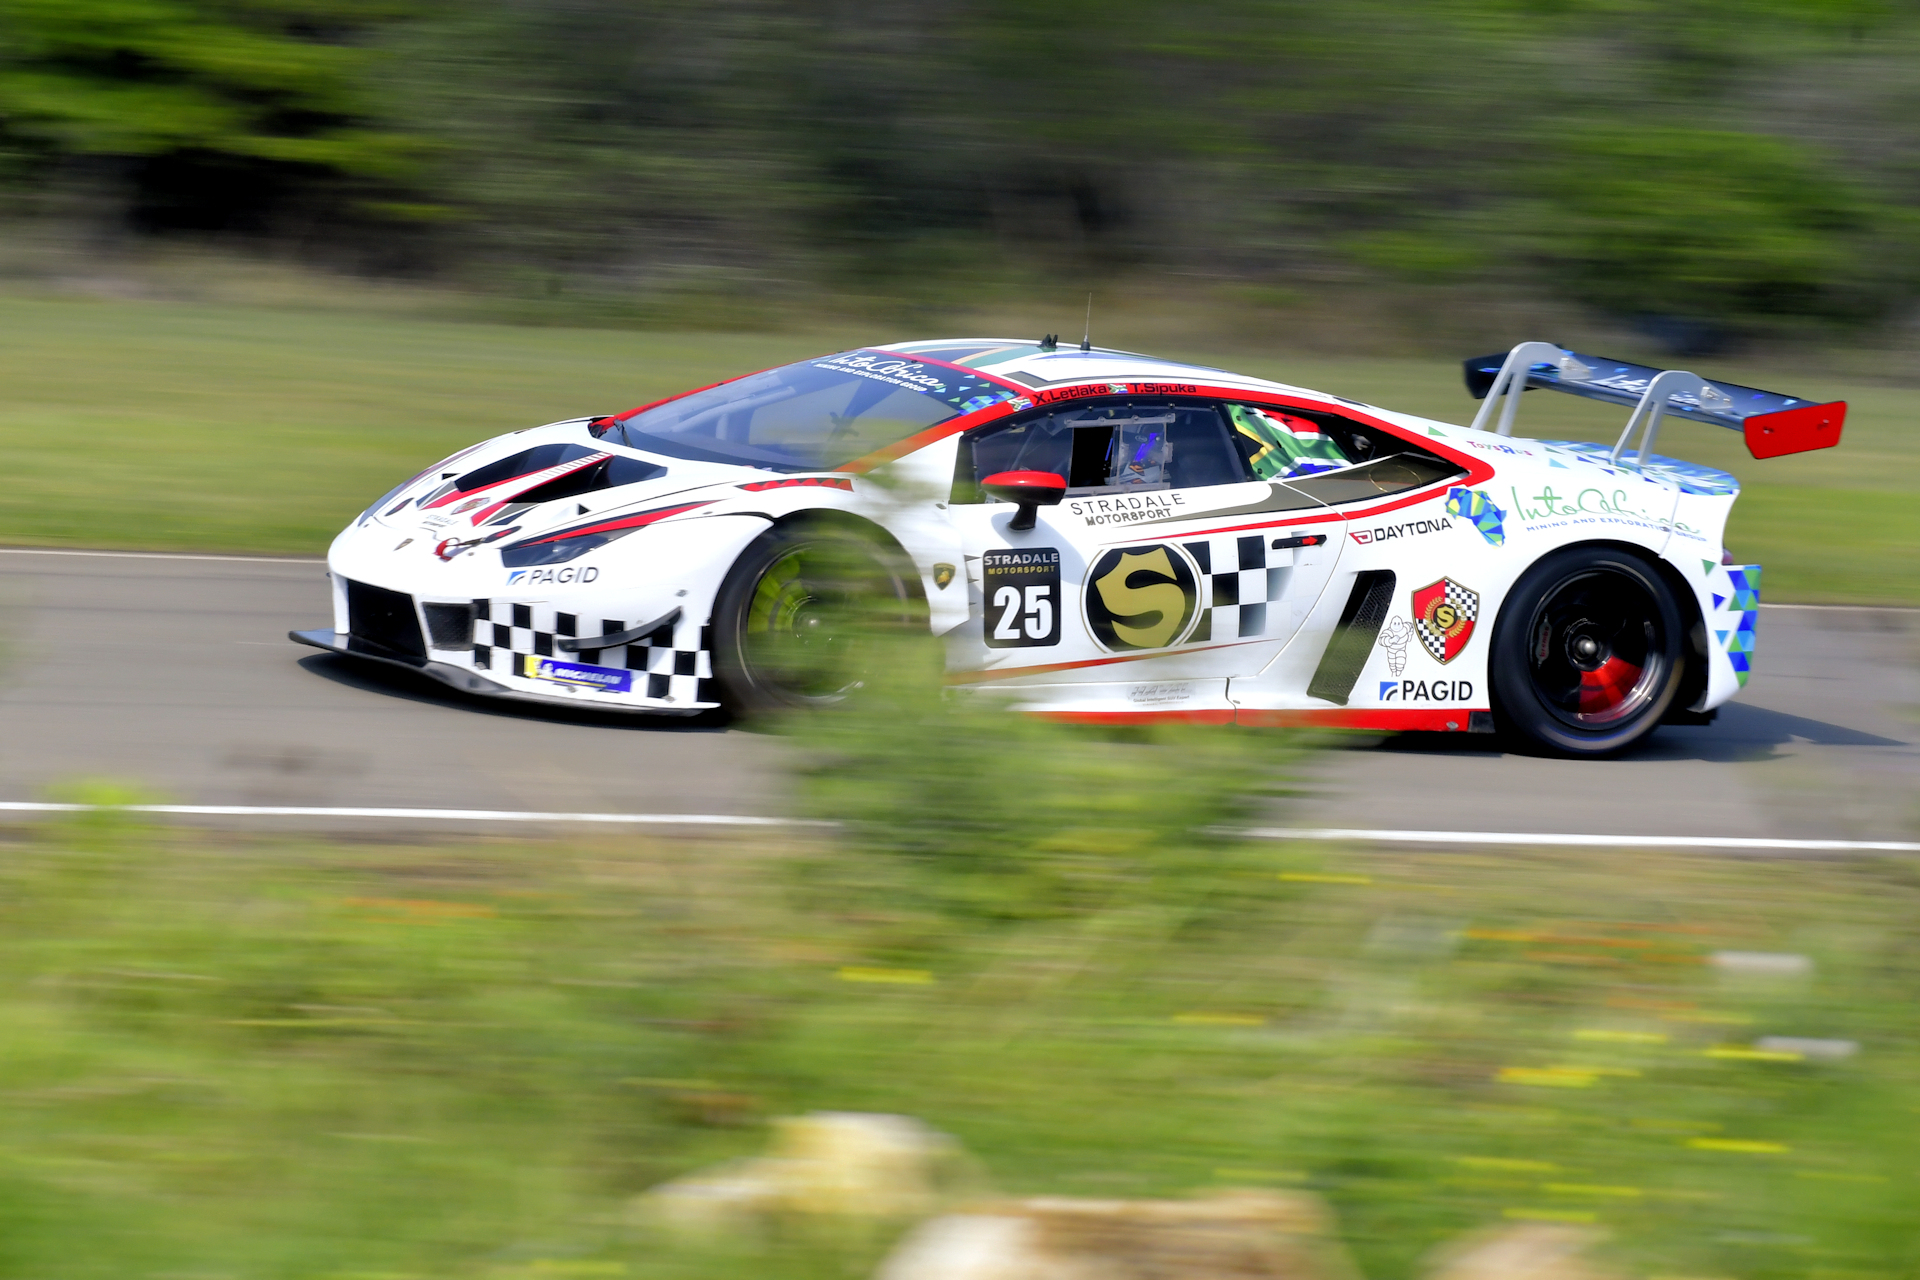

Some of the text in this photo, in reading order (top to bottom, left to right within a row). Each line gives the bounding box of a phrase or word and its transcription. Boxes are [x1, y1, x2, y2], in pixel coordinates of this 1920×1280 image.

[1070, 493, 1186, 515] STRADALE
[1085, 508, 1172, 526] MOTORSPORT
[1525, 520, 1569, 532] MINING
[1573, 517, 1597, 526] AND
[1374, 517, 1453, 542] DAYTONA
[984, 553, 1059, 566] STRADALE
[528, 566, 599, 585] PAGID
[987, 565, 1055, 575] MOTORSPORT
[993, 585, 1053, 640] 25
[1402, 680, 1473, 701] PAGID
